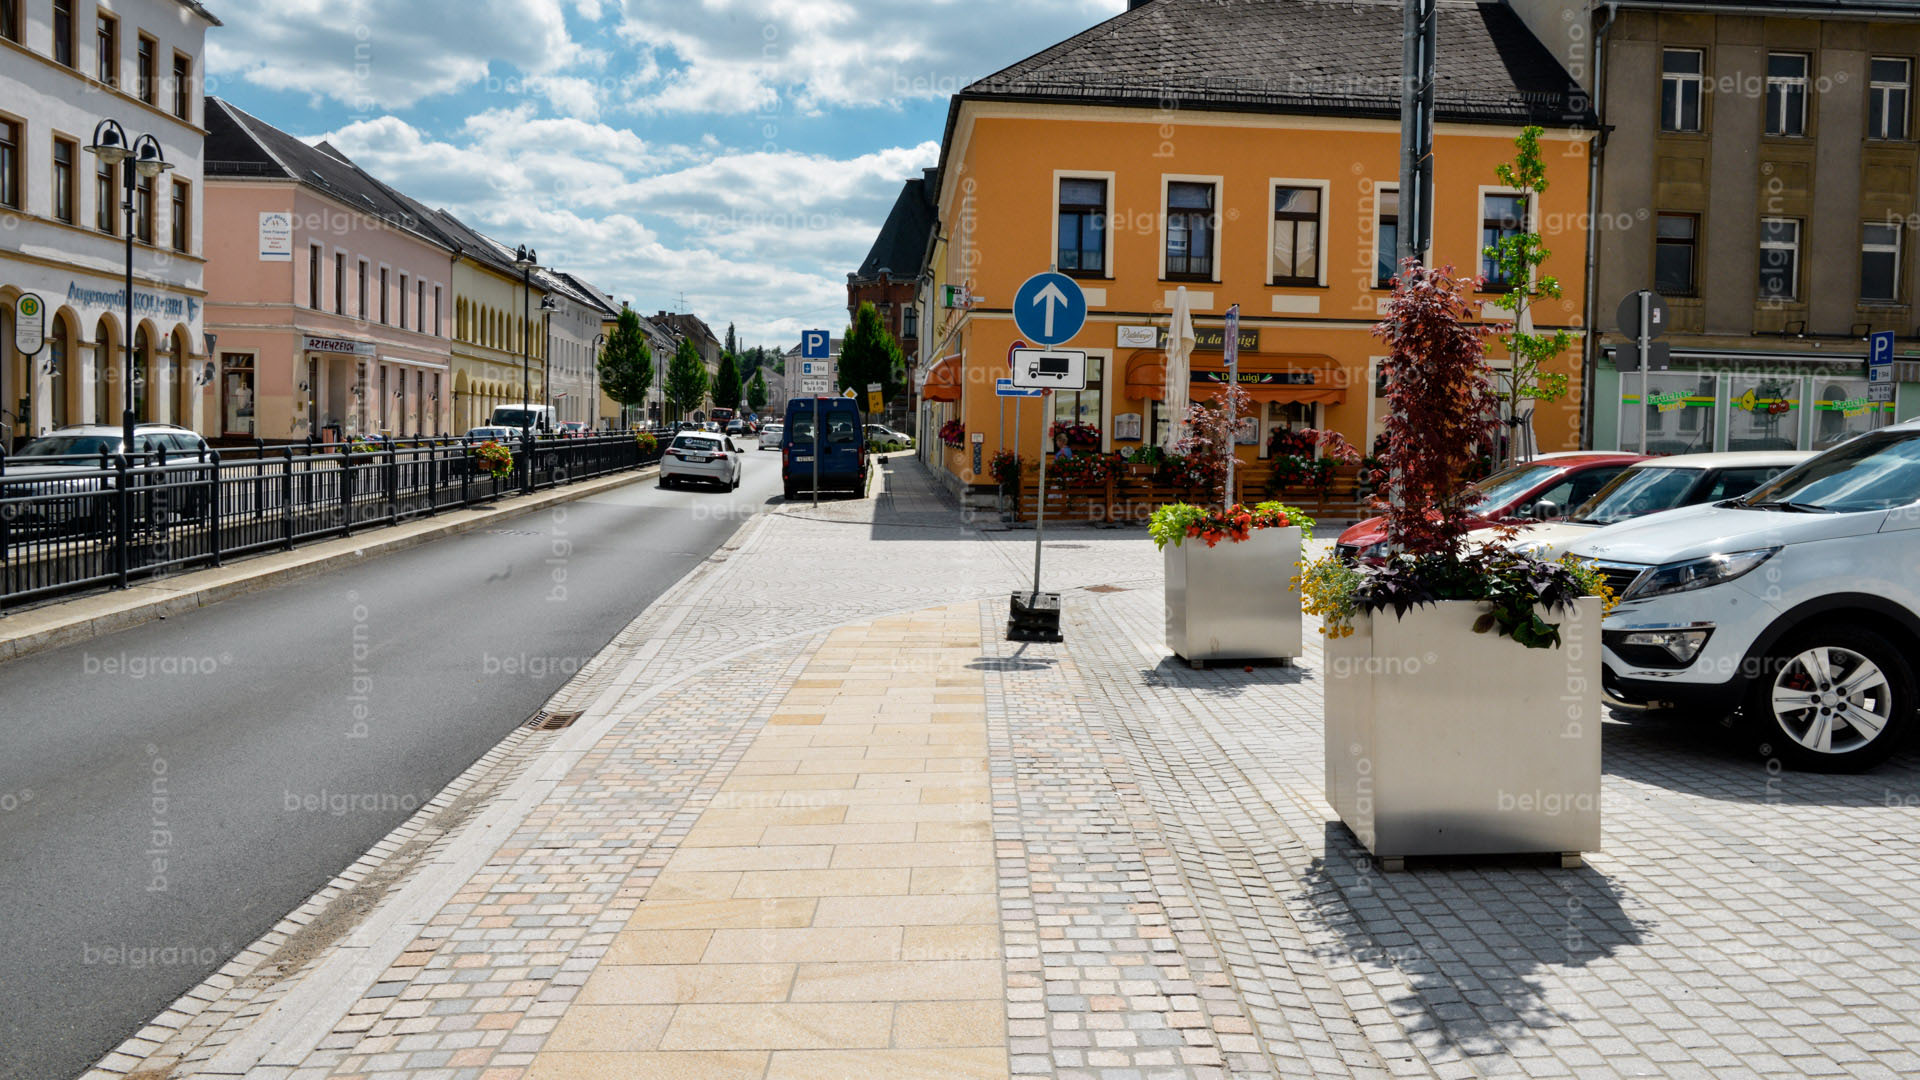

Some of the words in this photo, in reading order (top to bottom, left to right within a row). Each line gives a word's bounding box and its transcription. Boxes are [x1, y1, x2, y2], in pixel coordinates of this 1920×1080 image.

[807, 333, 823, 355] P
[1207, 333, 1222, 344] da
[1875, 336, 1888, 361] P
[1237, 373, 1260, 383] Luigi
